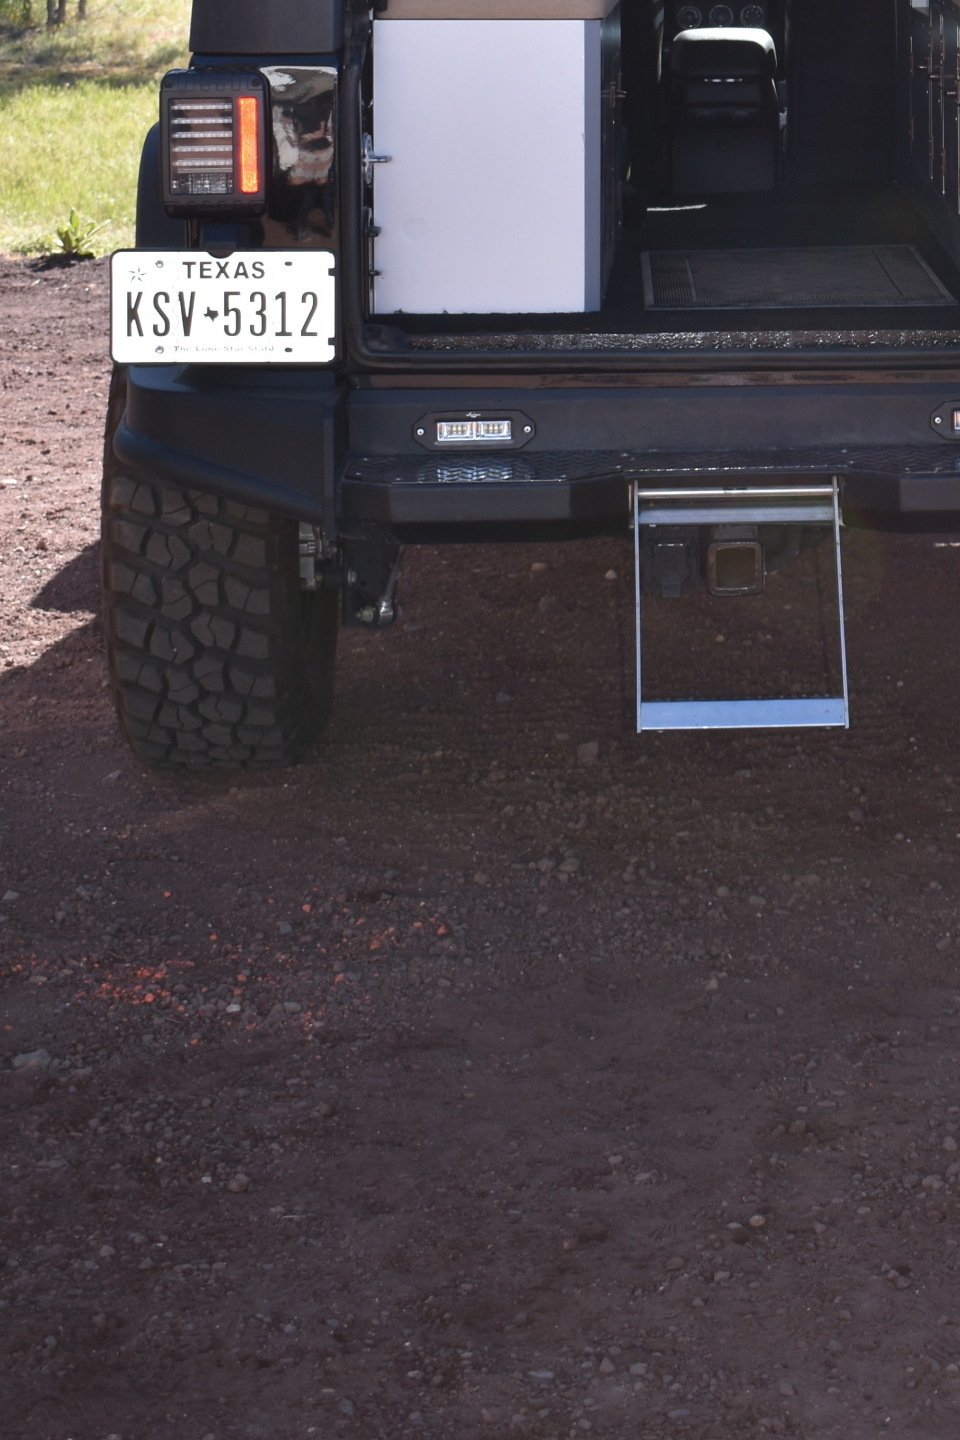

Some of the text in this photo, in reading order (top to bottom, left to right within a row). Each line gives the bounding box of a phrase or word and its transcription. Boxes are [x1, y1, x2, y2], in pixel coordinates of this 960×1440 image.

[182, 261, 265, 279] TEXAS
[127, 291, 318, 337] KSV 5312
